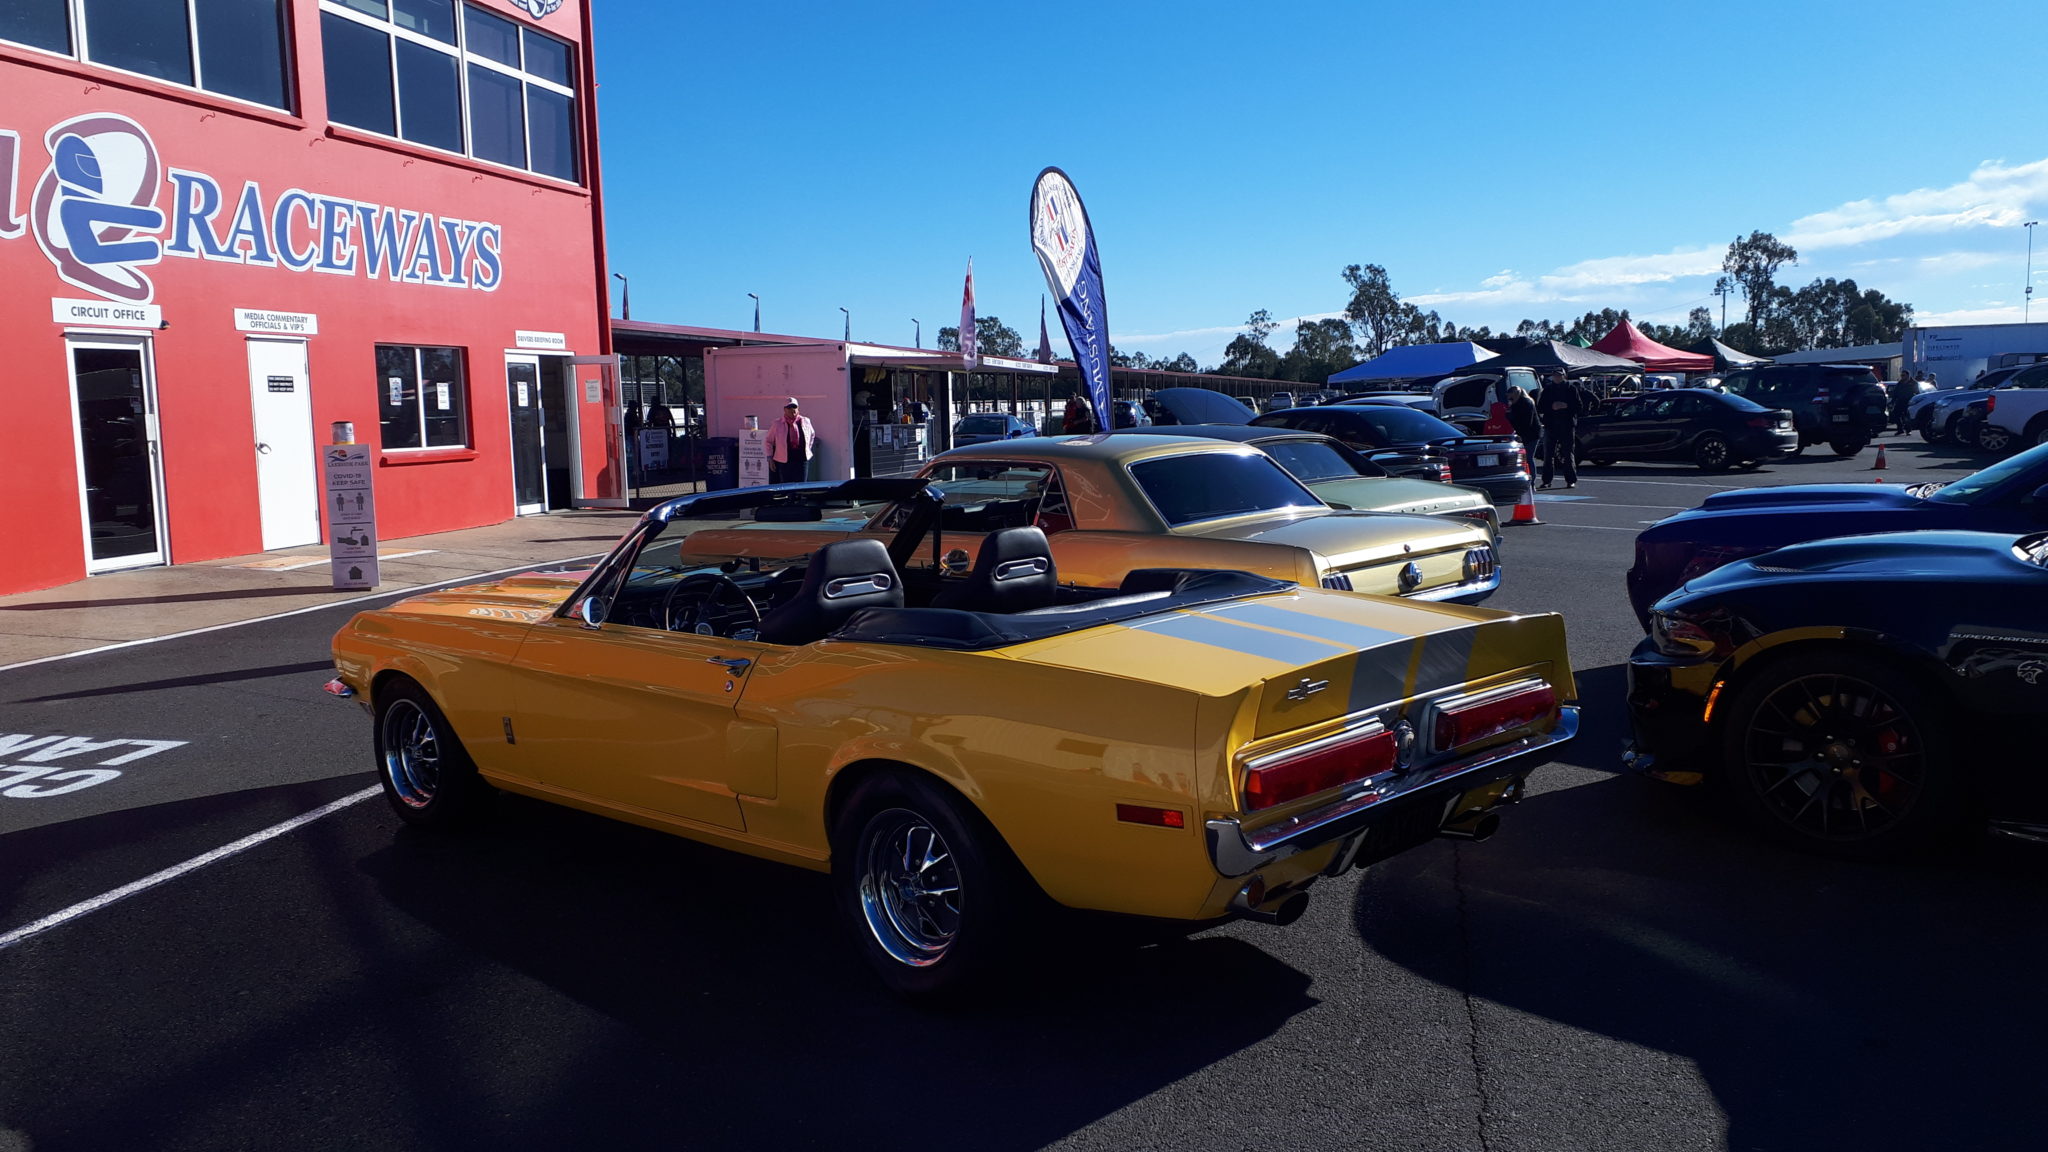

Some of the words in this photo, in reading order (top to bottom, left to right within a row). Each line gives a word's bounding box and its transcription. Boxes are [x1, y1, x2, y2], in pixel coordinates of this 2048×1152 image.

[163, 167, 502, 292] RACEWAYS
[71, 306, 109, 318] CIRCUIT
[113, 309, 145, 320] OFFICE
[244, 312, 265, 320] MEDIA
[267, 314, 308, 324] COMMENTARY
[250, 321, 281, 330] OFFICIALS
[283, 323, 288, 331] &
[1077, 280, 1104, 394] MUSTANG
